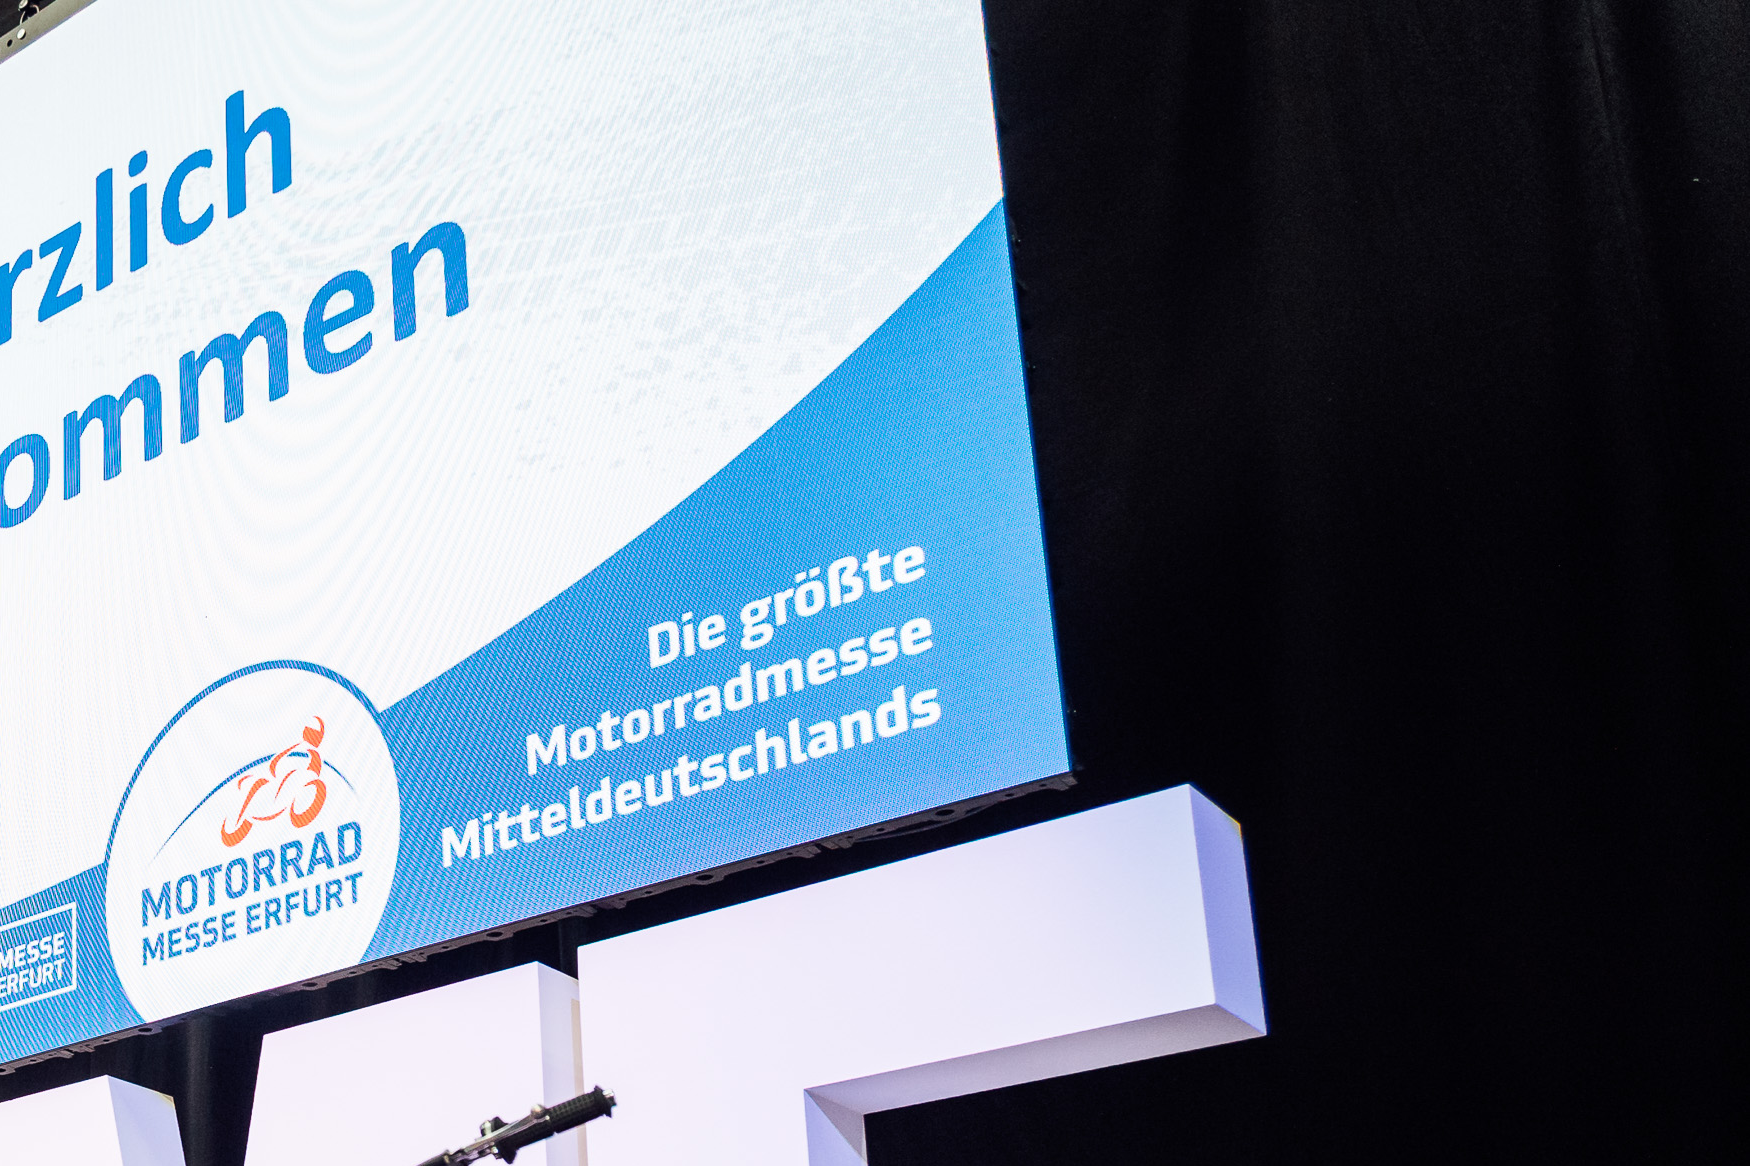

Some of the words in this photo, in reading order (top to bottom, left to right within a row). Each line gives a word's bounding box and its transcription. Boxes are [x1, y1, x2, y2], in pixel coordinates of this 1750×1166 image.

[647, 610, 726, 669] Die
[740, 544, 926, 652] größte
[526, 616, 934, 776] Motorradmesse
[441, 686, 943, 868] Mitteldeutschlands
[140, 821, 363, 928] MOTORRAD
[141, 909, 237, 967] MESSE
[246, 872, 363, 936] ERFURT
